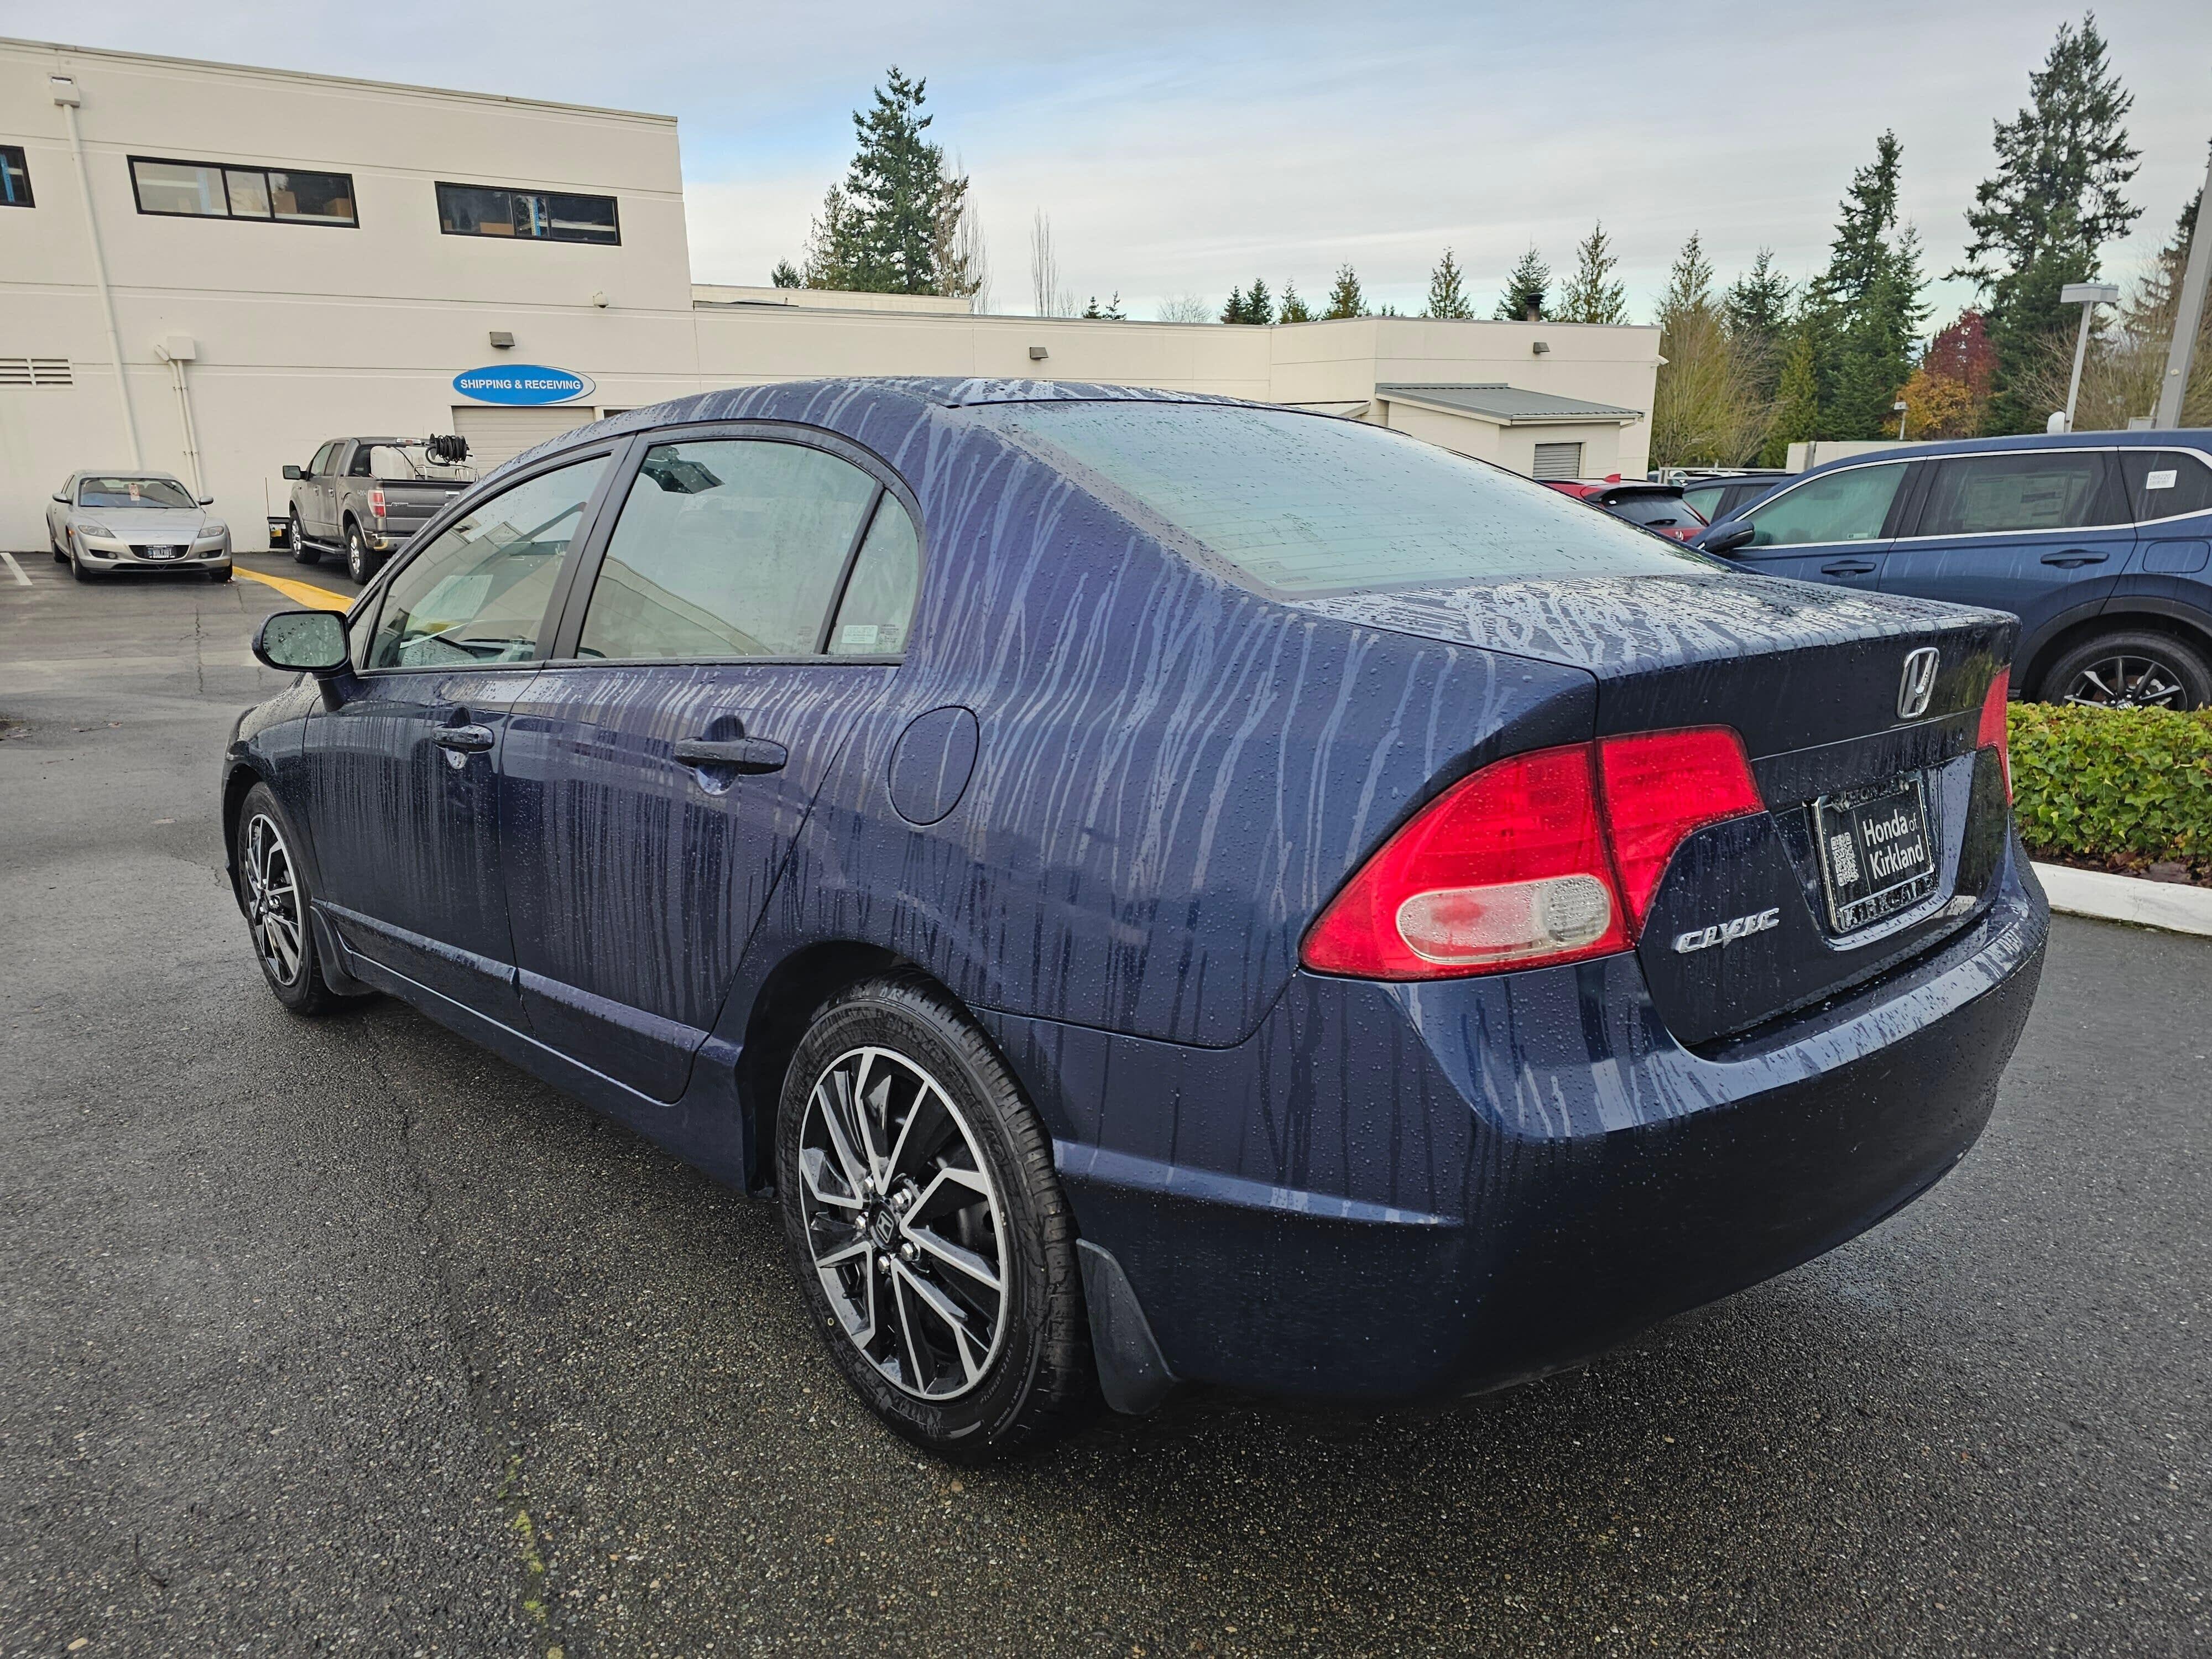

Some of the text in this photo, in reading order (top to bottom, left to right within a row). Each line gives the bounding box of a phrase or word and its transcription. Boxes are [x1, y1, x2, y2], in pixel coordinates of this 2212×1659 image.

[460, 379, 581, 390] SHIPPING & RECEIVING
[1846, 778, 1900, 807] HONDA
[1862, 808, 1918, 847] Honda of
[1869, 834, 1925, 880] Kirkland
[1843, 874, 1934, 930] KIRKLAND
[1674, 907, 1780, 953] CIVIC
